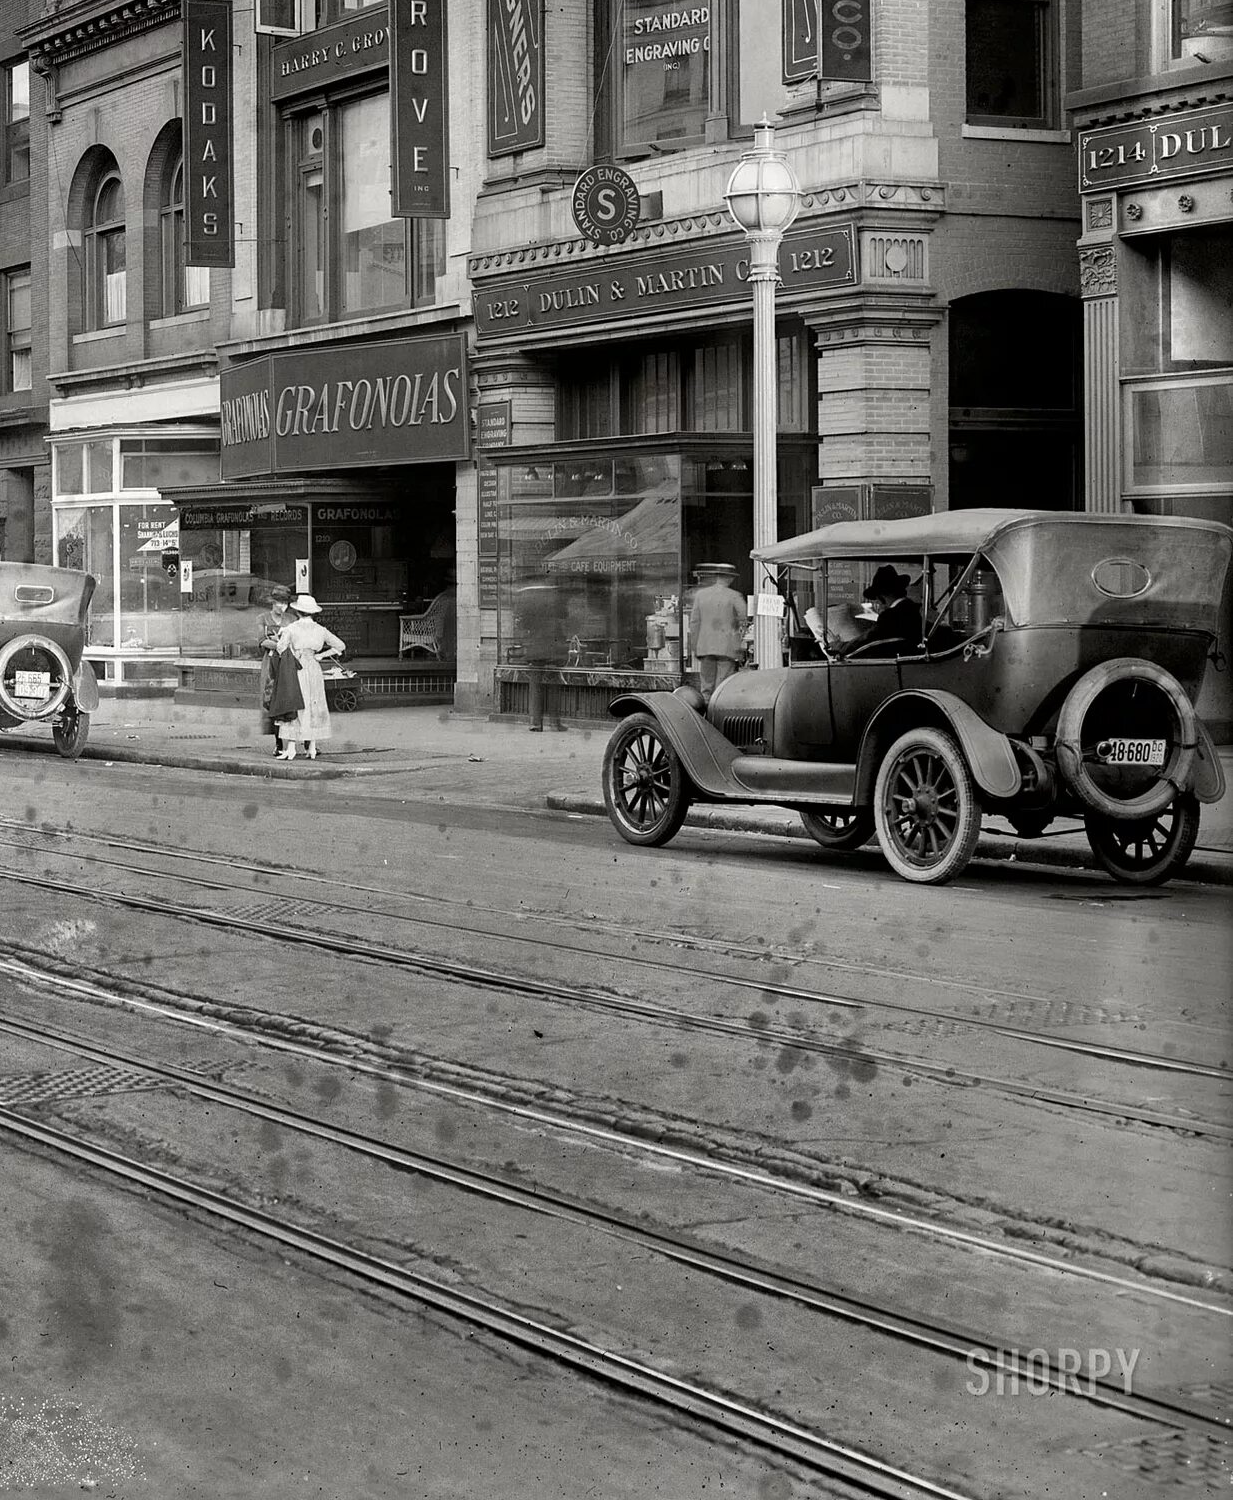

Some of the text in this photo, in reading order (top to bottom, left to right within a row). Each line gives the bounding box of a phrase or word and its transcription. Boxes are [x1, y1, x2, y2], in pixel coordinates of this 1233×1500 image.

[634, 7, 709, 35] STANDARD
[831, 0, 863, 61] CO.
[281, 46, 330, 76] HARRY
[336, 42, 347, 57] C.
[626, 38, 701, 66] ENGRAVING
[200, 28, 219, 235] KODAKS
[1089, 125, 1231, 170] 1214 DUL
[575, 174, 602, 239] STANDARD
[597, 168, 638, 229] ENGRAVING
[597, 188, 616, 220] S
[487, 248, 836, 321] 1212 DULIN & MARTIN C 1212
[276, 368, 459, 437] GRAFONOLAS
[270, 509, 303, 521] RECORDS
[593, 560, 637, 573] EQUIPMENT
